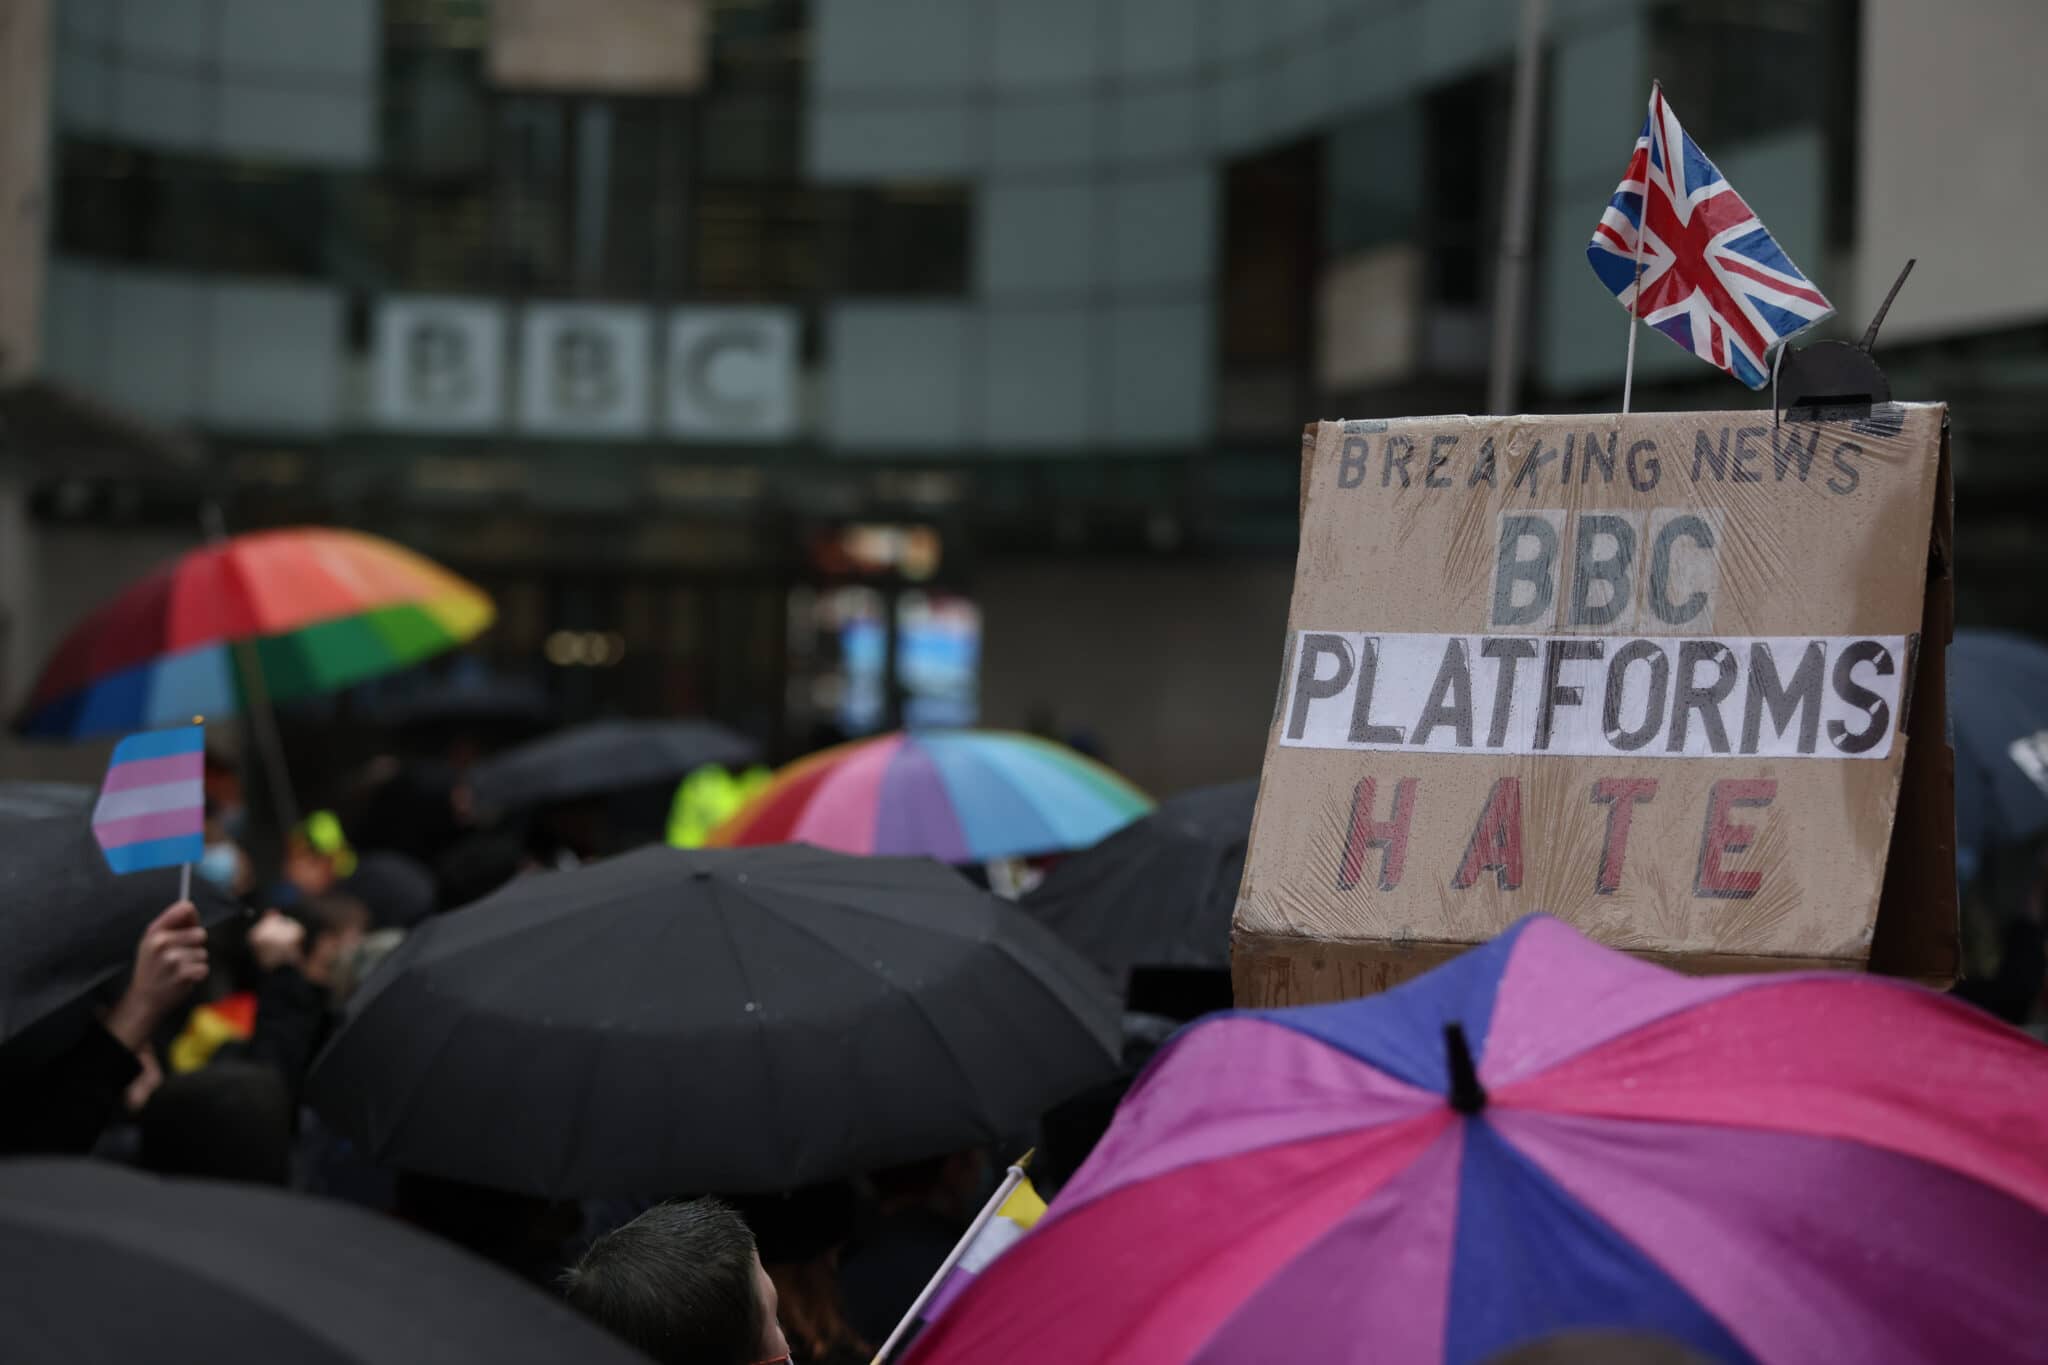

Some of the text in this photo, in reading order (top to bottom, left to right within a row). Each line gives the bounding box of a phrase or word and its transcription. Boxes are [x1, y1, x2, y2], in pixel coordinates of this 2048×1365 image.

[406, 318, 774, 418] BBC
[1337, 426, 1863, 498] BREAKING NEWS
[1493, 512, 1716, 627] BBC
[1286, 634, 1895, 755] PLATFORMS
[1336, 775, 1779, 900] HATE
